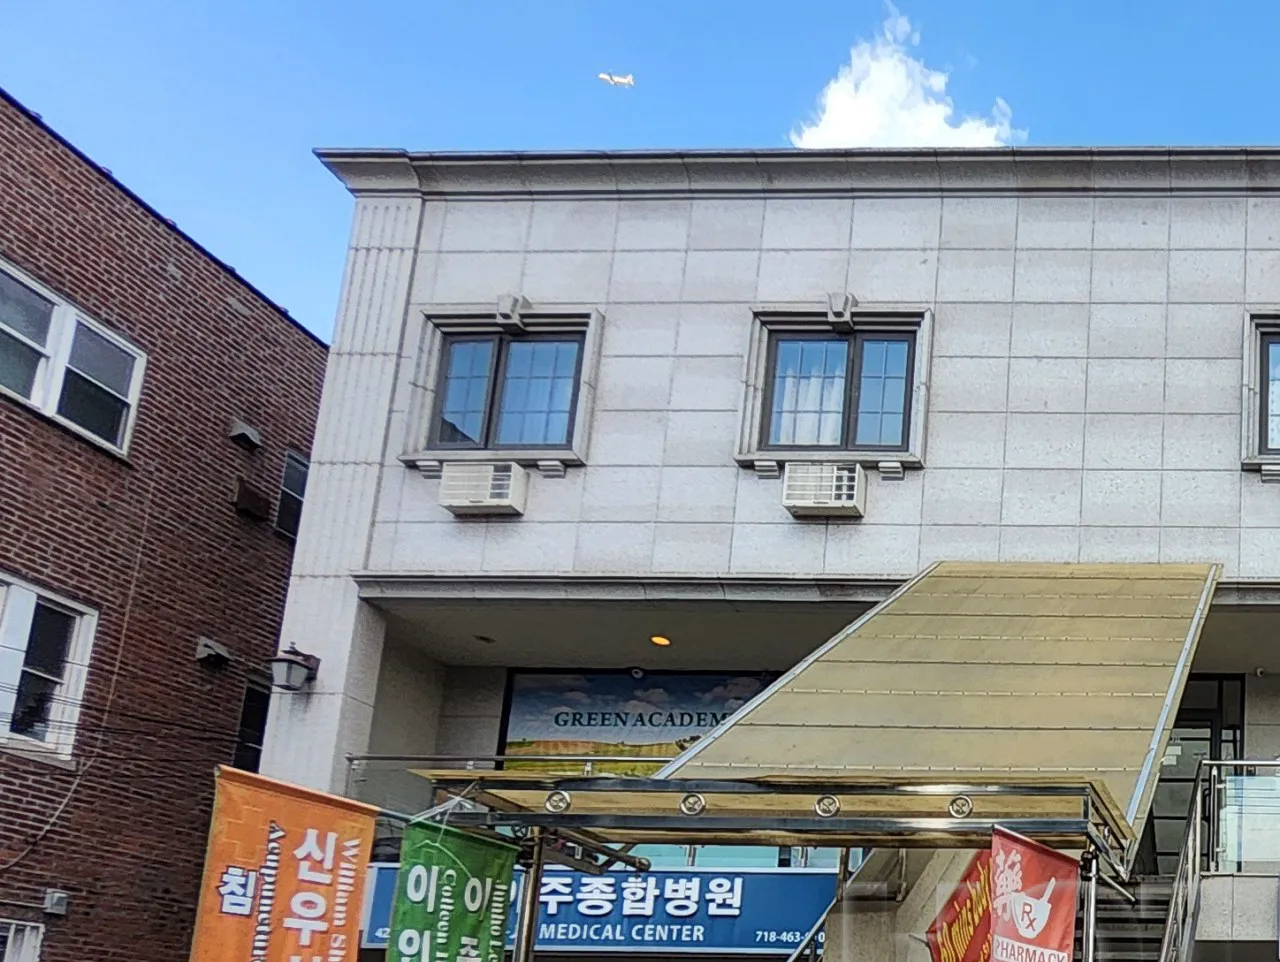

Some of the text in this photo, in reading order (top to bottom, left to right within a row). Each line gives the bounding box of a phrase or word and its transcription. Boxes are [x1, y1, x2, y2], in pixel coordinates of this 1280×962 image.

[554, 711, 731, 728] GREEN ACADEM
[218, 863, 257, 916] 침
[539, 923, 628, 941] MEDICAL
[631, 924, 706, 943] CENTER
